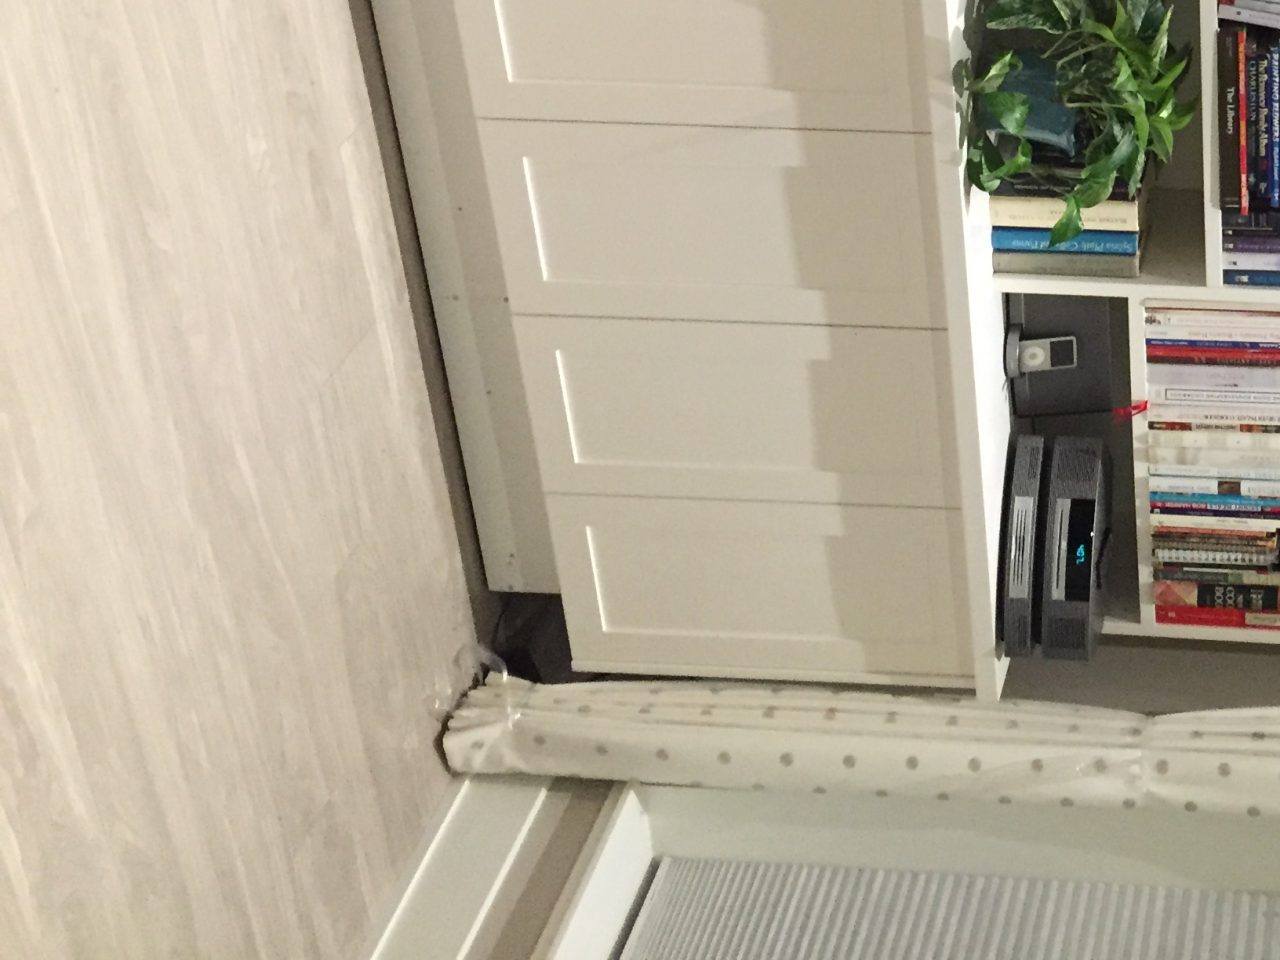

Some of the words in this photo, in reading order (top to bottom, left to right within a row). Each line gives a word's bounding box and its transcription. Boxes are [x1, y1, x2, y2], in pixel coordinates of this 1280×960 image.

[1226, 86, 1236, 103] The
[1249, 60, 1257, 121] CHARLESTON
[1271, 52, 1280, 101] PAINTING
[1225, 104, 1236, 135] Library
[1271, 103, 1280, 143] FLOWERS
